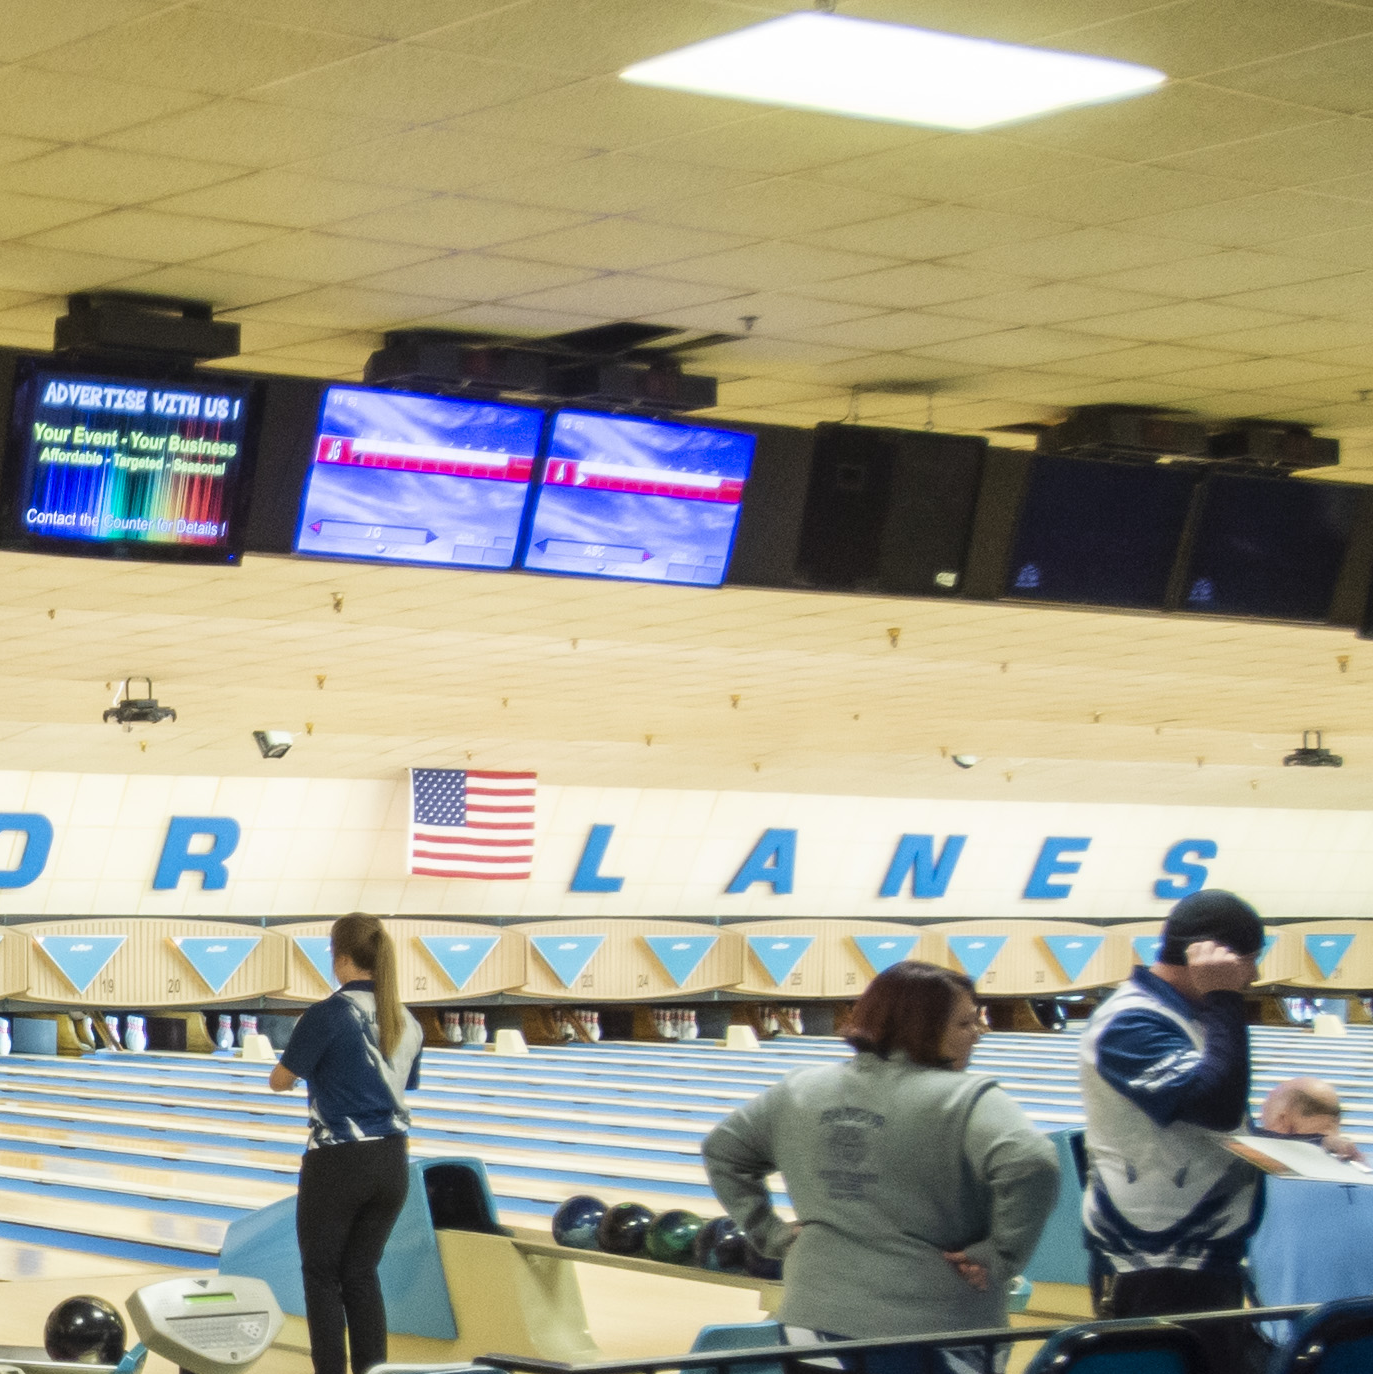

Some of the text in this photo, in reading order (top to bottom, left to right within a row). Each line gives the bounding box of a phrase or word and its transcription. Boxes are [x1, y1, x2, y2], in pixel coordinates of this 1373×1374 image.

[44, 381, 148, 411] ADVERTISE
[152, 391, 200, 417] WITH
[204, 397, 230, 418] US
[34, 422, 71, 443] Your
[72, 426, 118, 447] Event
[131, 432, 166, 451] Your
[168, 434, 237, 458] Business
[39, 447, 103, 465] Affordable
[113, 453, 164, 471] Targeted
[173, 458, 226, 476] Seasonal
[26, 508, 77, 526] Contact
[80, 511, 99, 527] the
[104, 514, 154, 531] Counter
[157, 517, 174, 532] for
[176, 519, 218, 537] Details
[569, 823, 1219, 900] LANES
[102, 978, 114, 993] 19
[168, 978, 181, 993] 20
[415, 977, 427, 991] 22
[638, 974, 649, 988] 24
